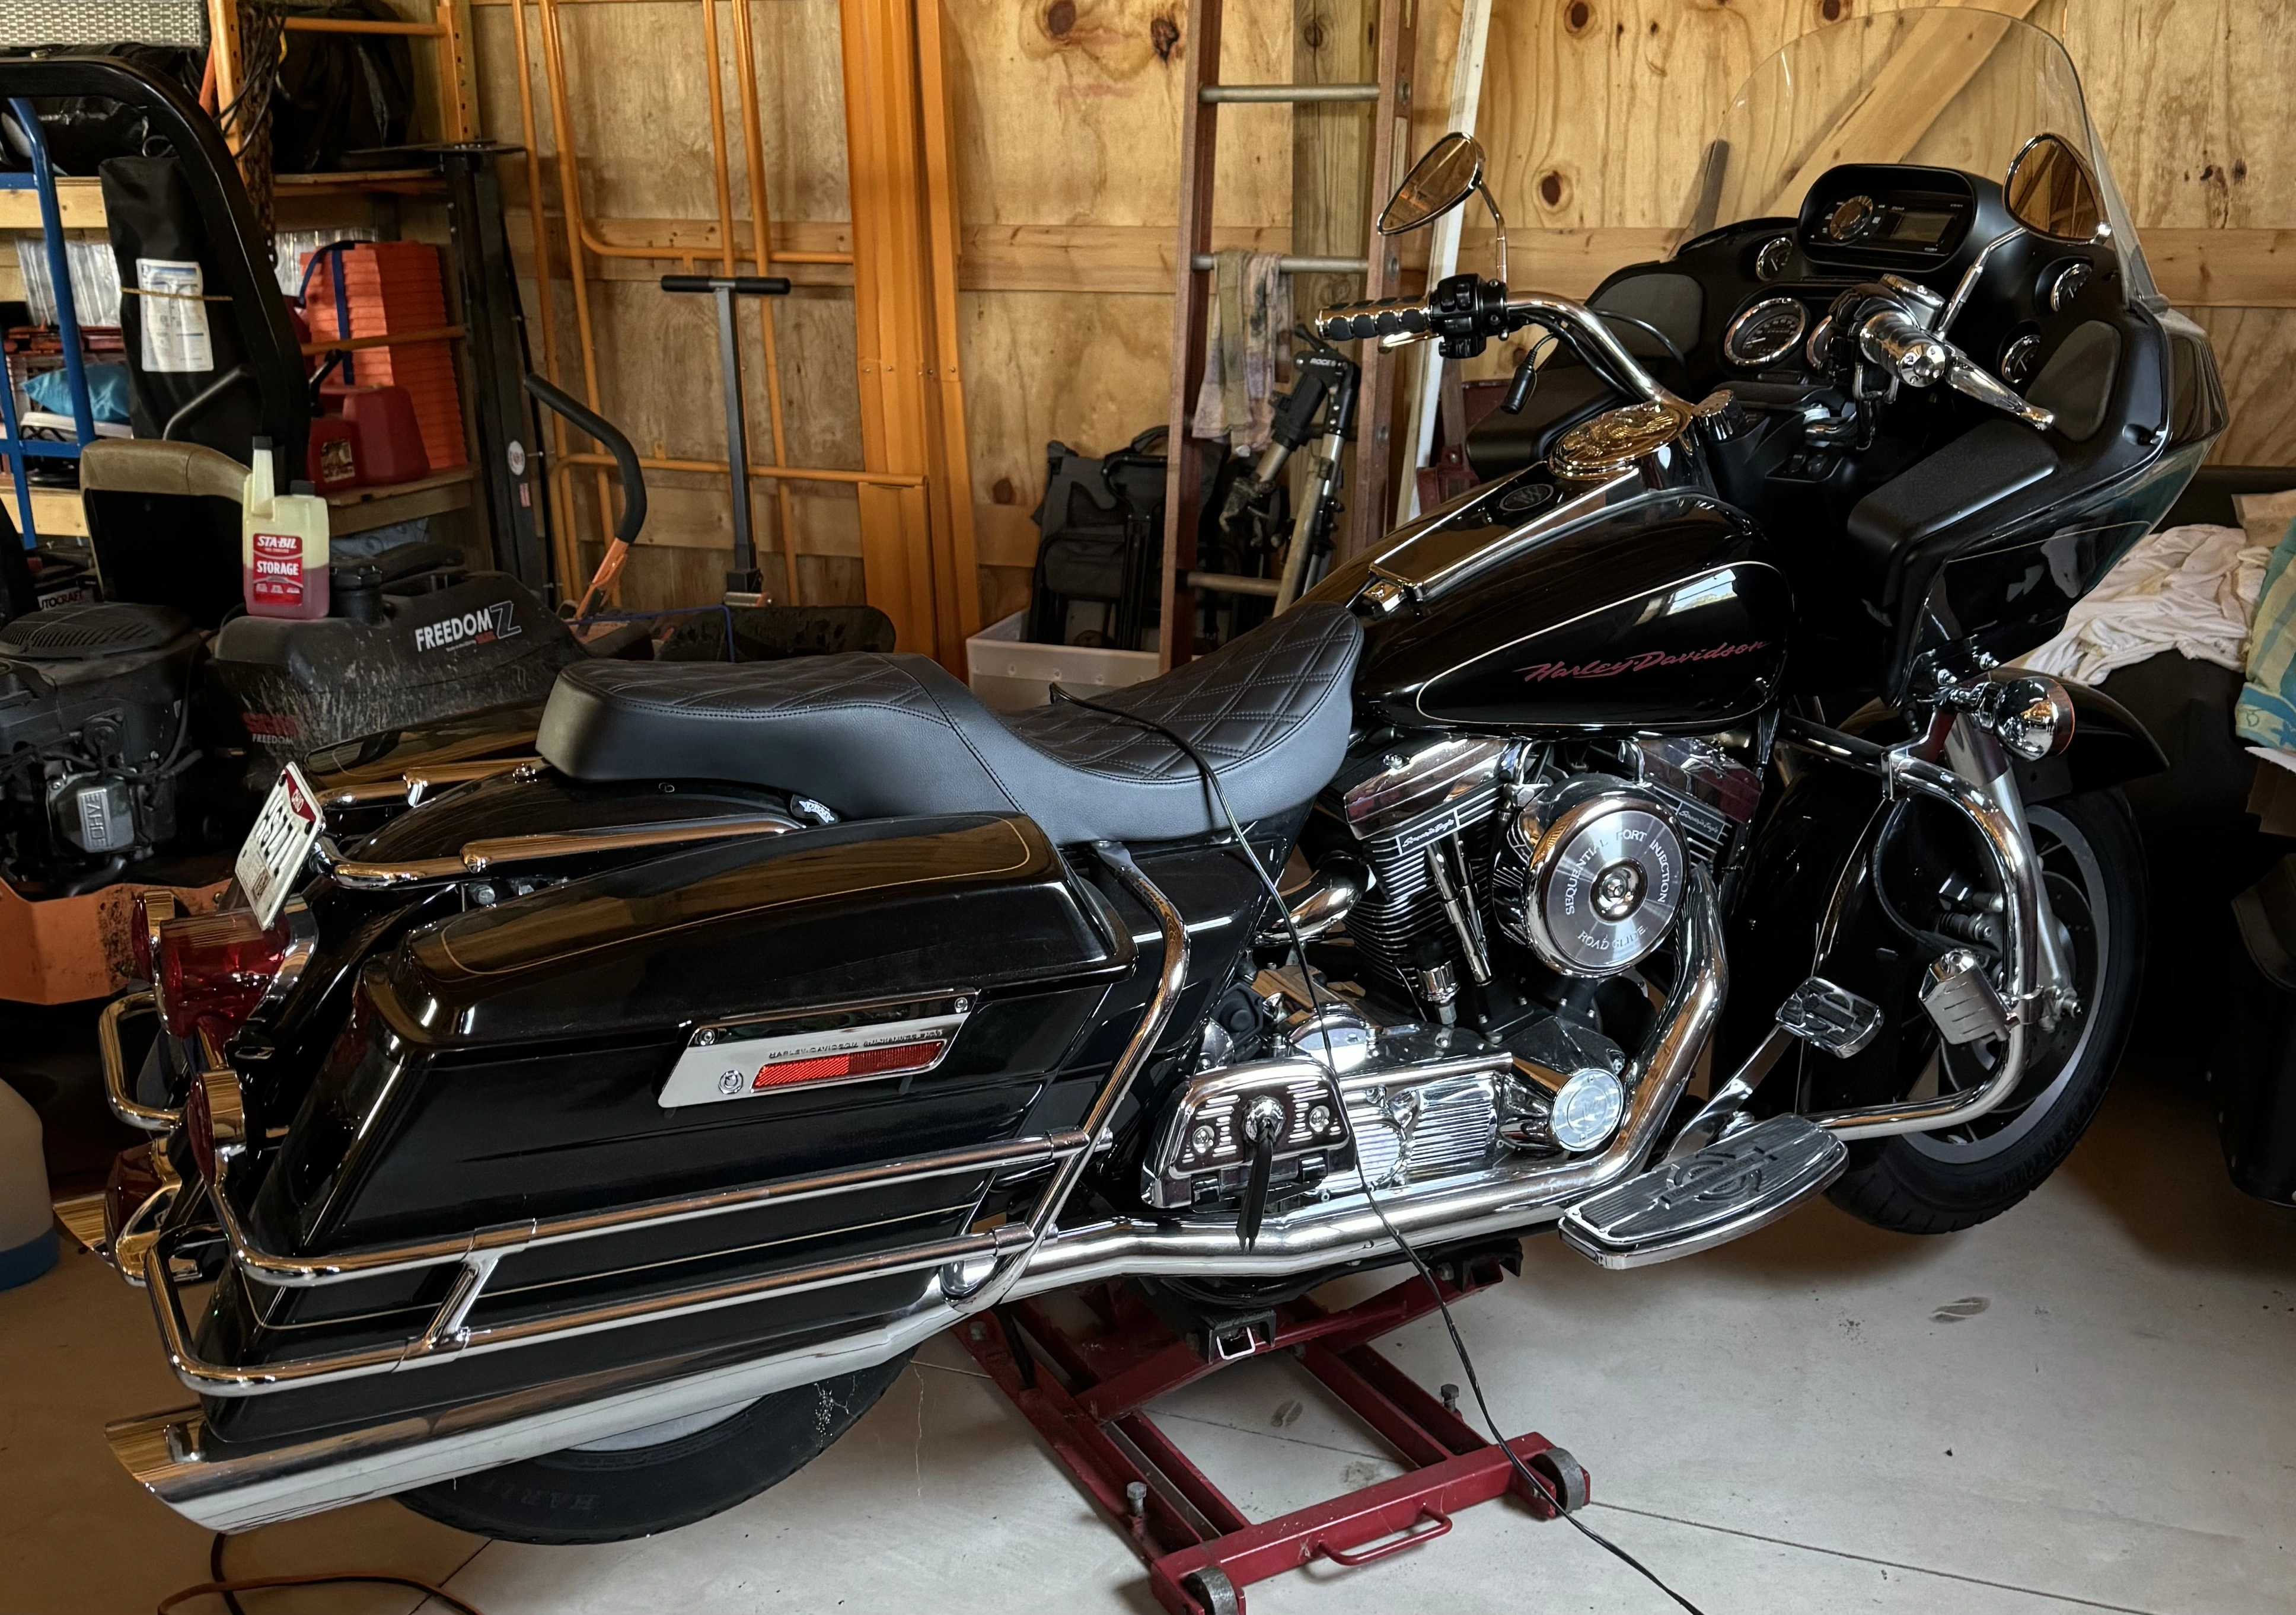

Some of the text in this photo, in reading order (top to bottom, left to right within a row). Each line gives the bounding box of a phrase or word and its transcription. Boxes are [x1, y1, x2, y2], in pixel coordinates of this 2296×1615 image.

[257, 535, 297, 549] STA-BIL
[257, 560, 299, 576] STORAGE
[41, 591, 82, 609] UTOCRAFT
[415, 608, 493, 652] FREEDOM
[1513, 641, 1772, 682] Harley-Davidson
[252, 733, 294, 745] FREEDOM
[1565, 838, 1609, 916] SEQUENTIAL
[1649, 838, 1670, 903] INJECTION
[1577, 924, 1648, 950] ROAD GLIDE
